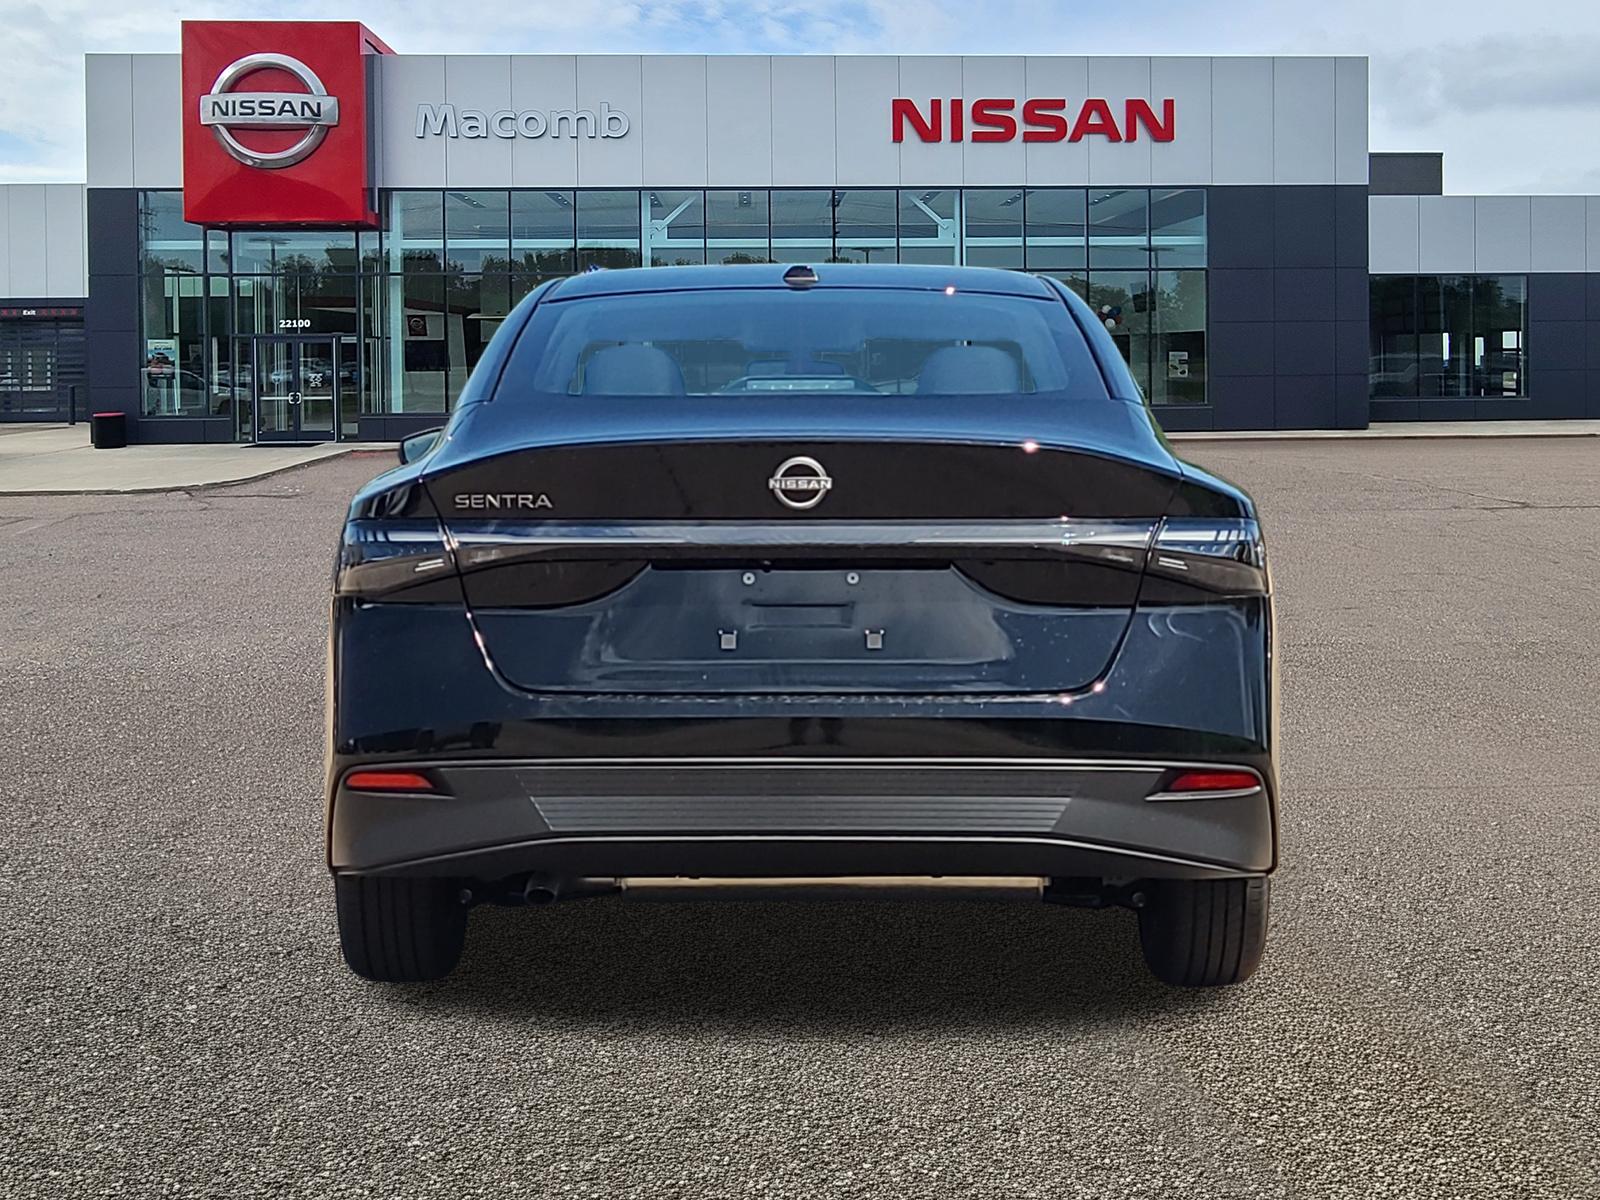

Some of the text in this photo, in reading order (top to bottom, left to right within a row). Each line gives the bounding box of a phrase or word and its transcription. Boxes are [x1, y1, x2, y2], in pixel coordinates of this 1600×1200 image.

[211, 100, 322, 118] NISSAN
[415, 101, 630, 139] Macomb
[892, 98, 1175, 142] NISSAN
[279, 319, 311, 328] 22100
[768, 479, 832, 490] NISSAN
[454, 494, 553, 508] SENTRA
